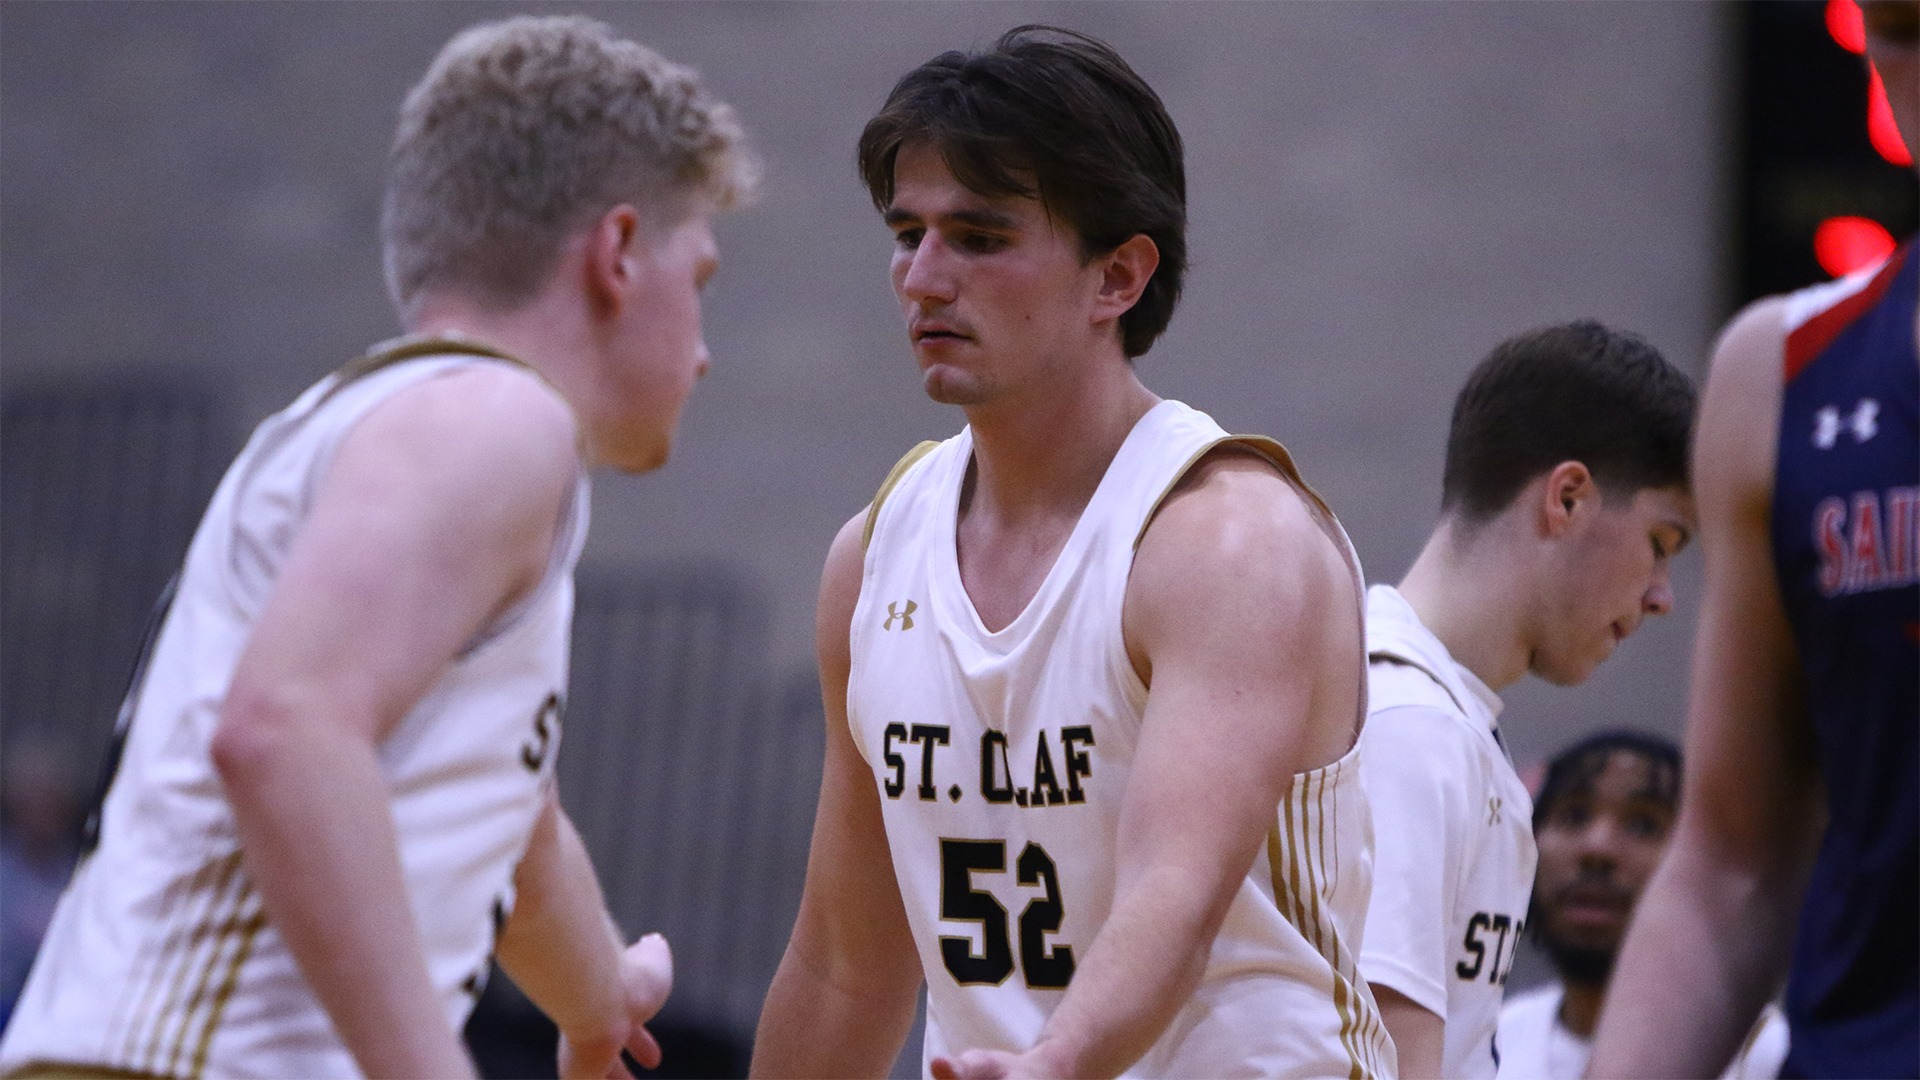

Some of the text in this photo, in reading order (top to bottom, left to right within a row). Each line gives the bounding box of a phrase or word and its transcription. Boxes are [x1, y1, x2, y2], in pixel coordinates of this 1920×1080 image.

[1811, 486, 1920, 598] SAI
[883, 721, 962, 804] ST.
[938, 836, 1076, 990] 52
